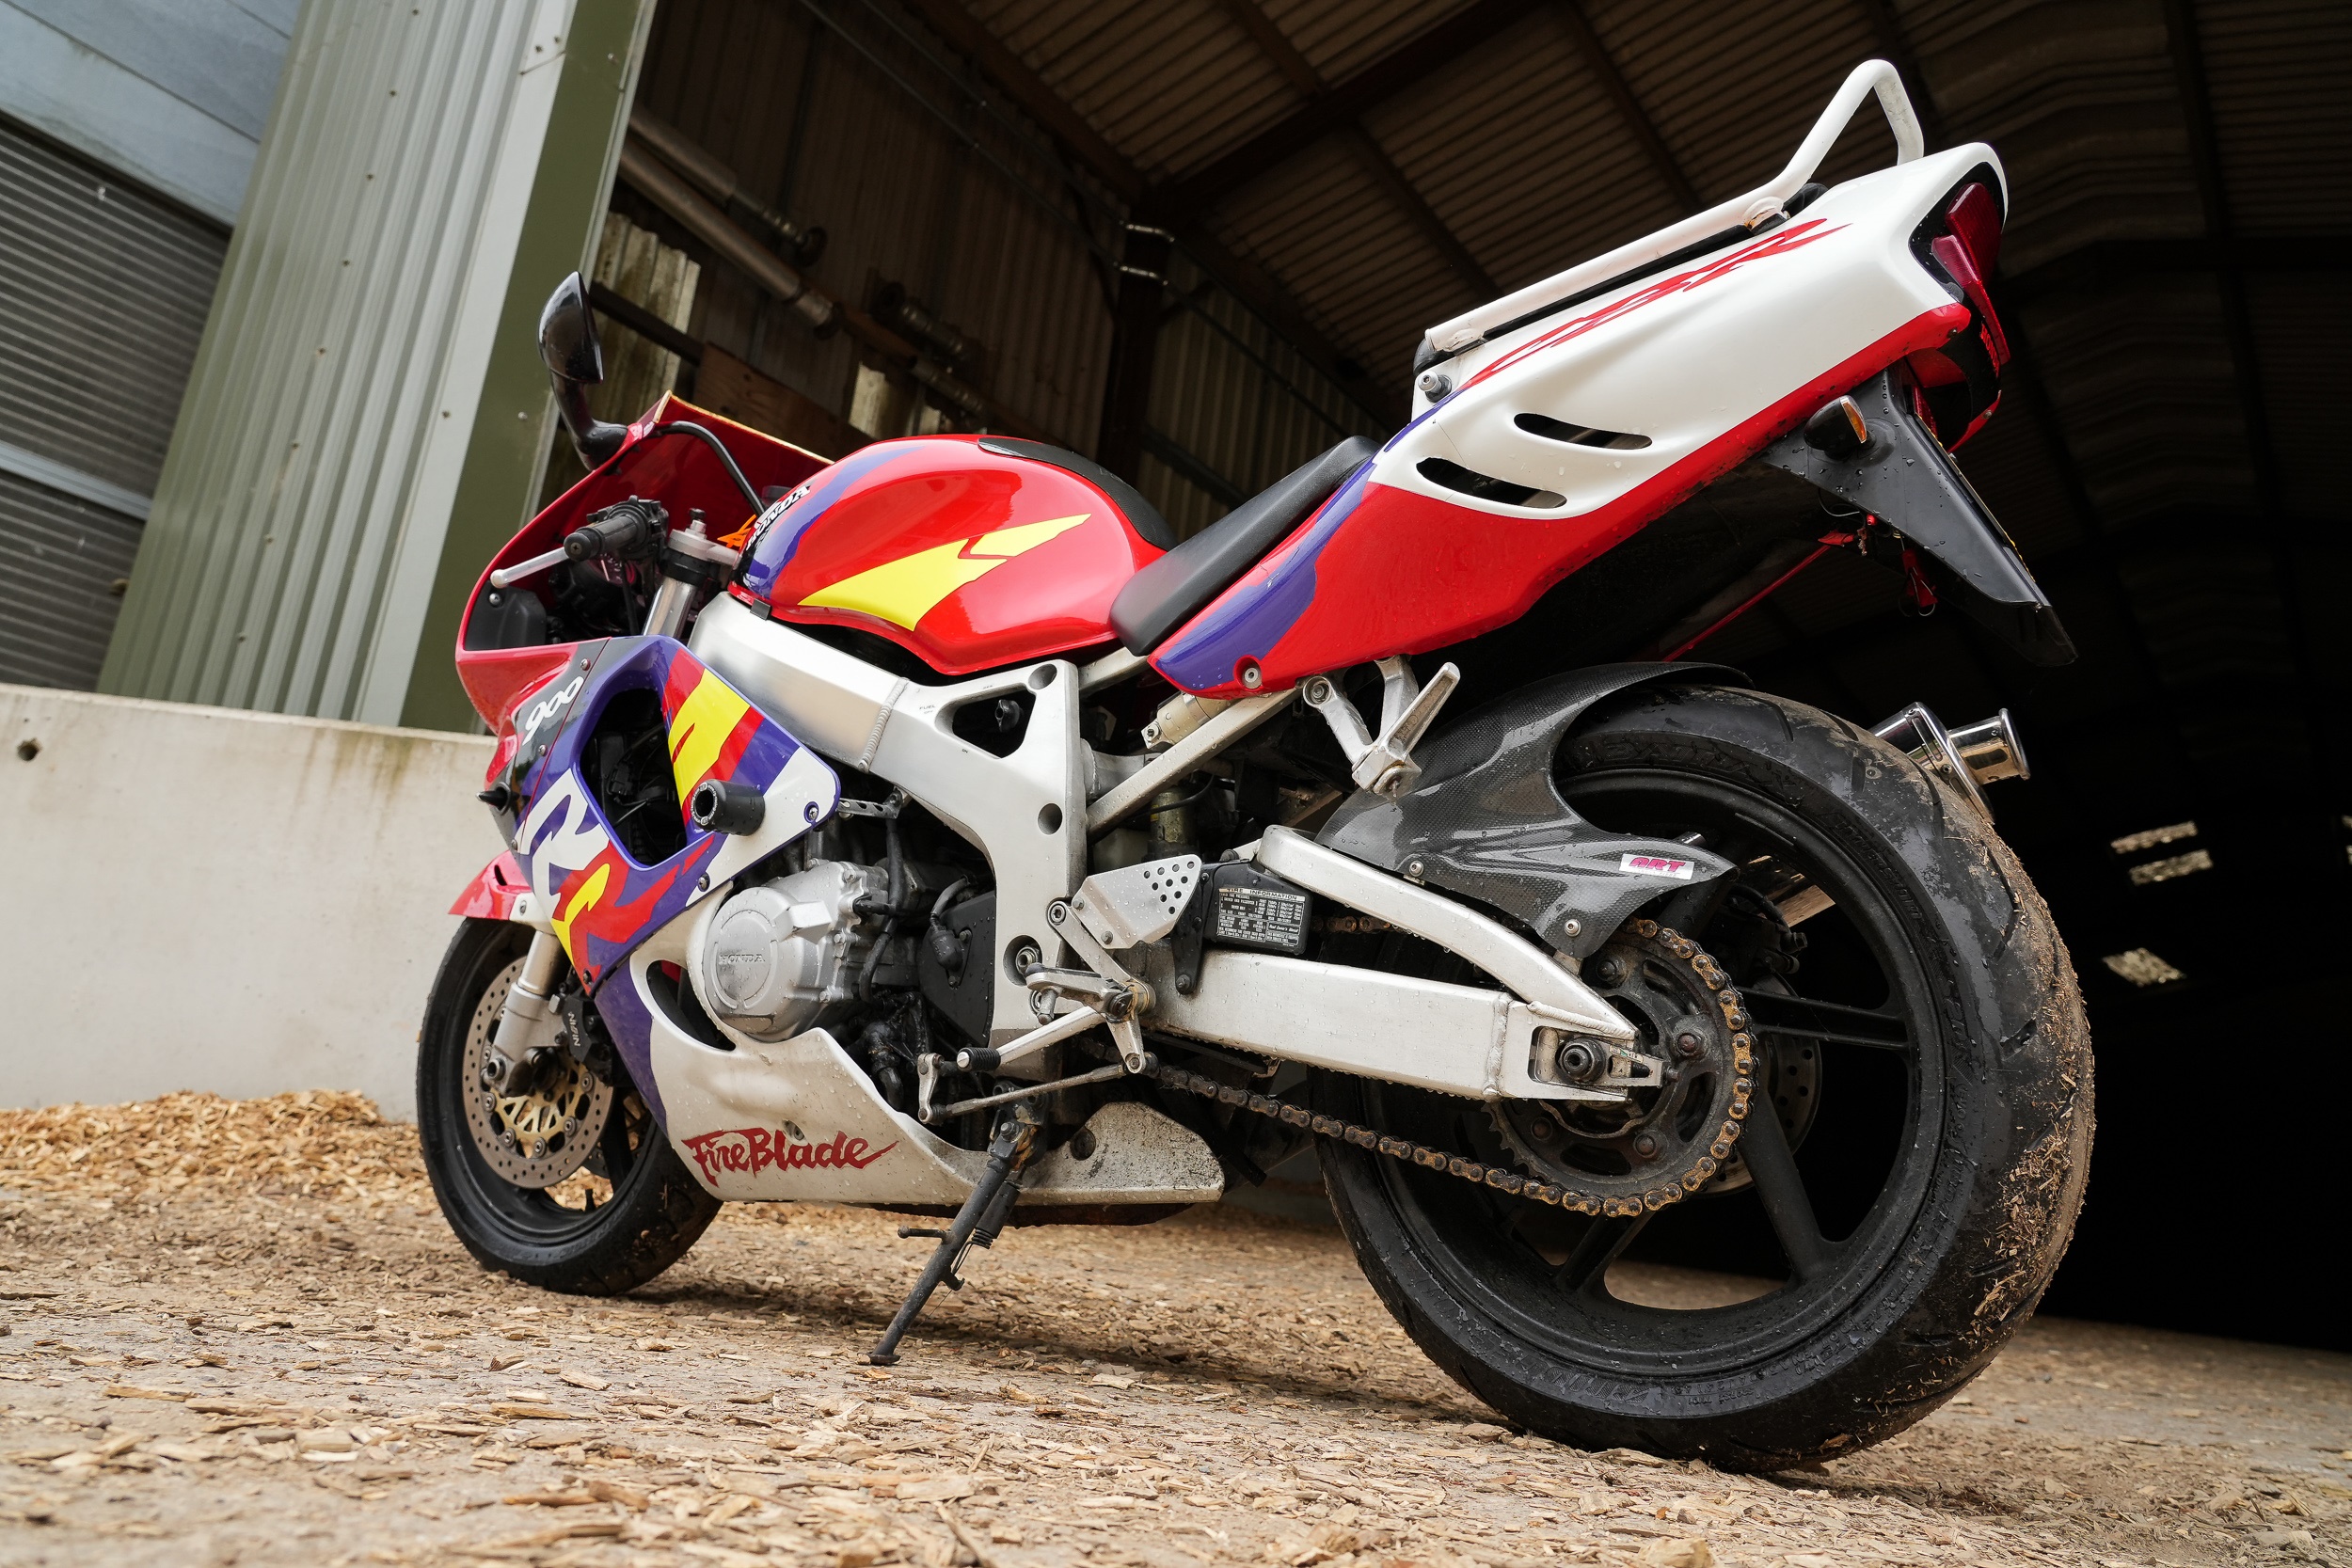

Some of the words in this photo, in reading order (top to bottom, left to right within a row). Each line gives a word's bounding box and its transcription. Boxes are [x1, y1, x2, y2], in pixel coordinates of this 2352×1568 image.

[746, 486, 810, 550] HONDA
[522, 676, 584, 746] 900
[1629, 857, 1686, 872] ART
[1249, 890, 1297, 900] INFORMATION
[718, 954, 765, 965] HONDA
[681, 1127, 899, 1187] FireBlade
